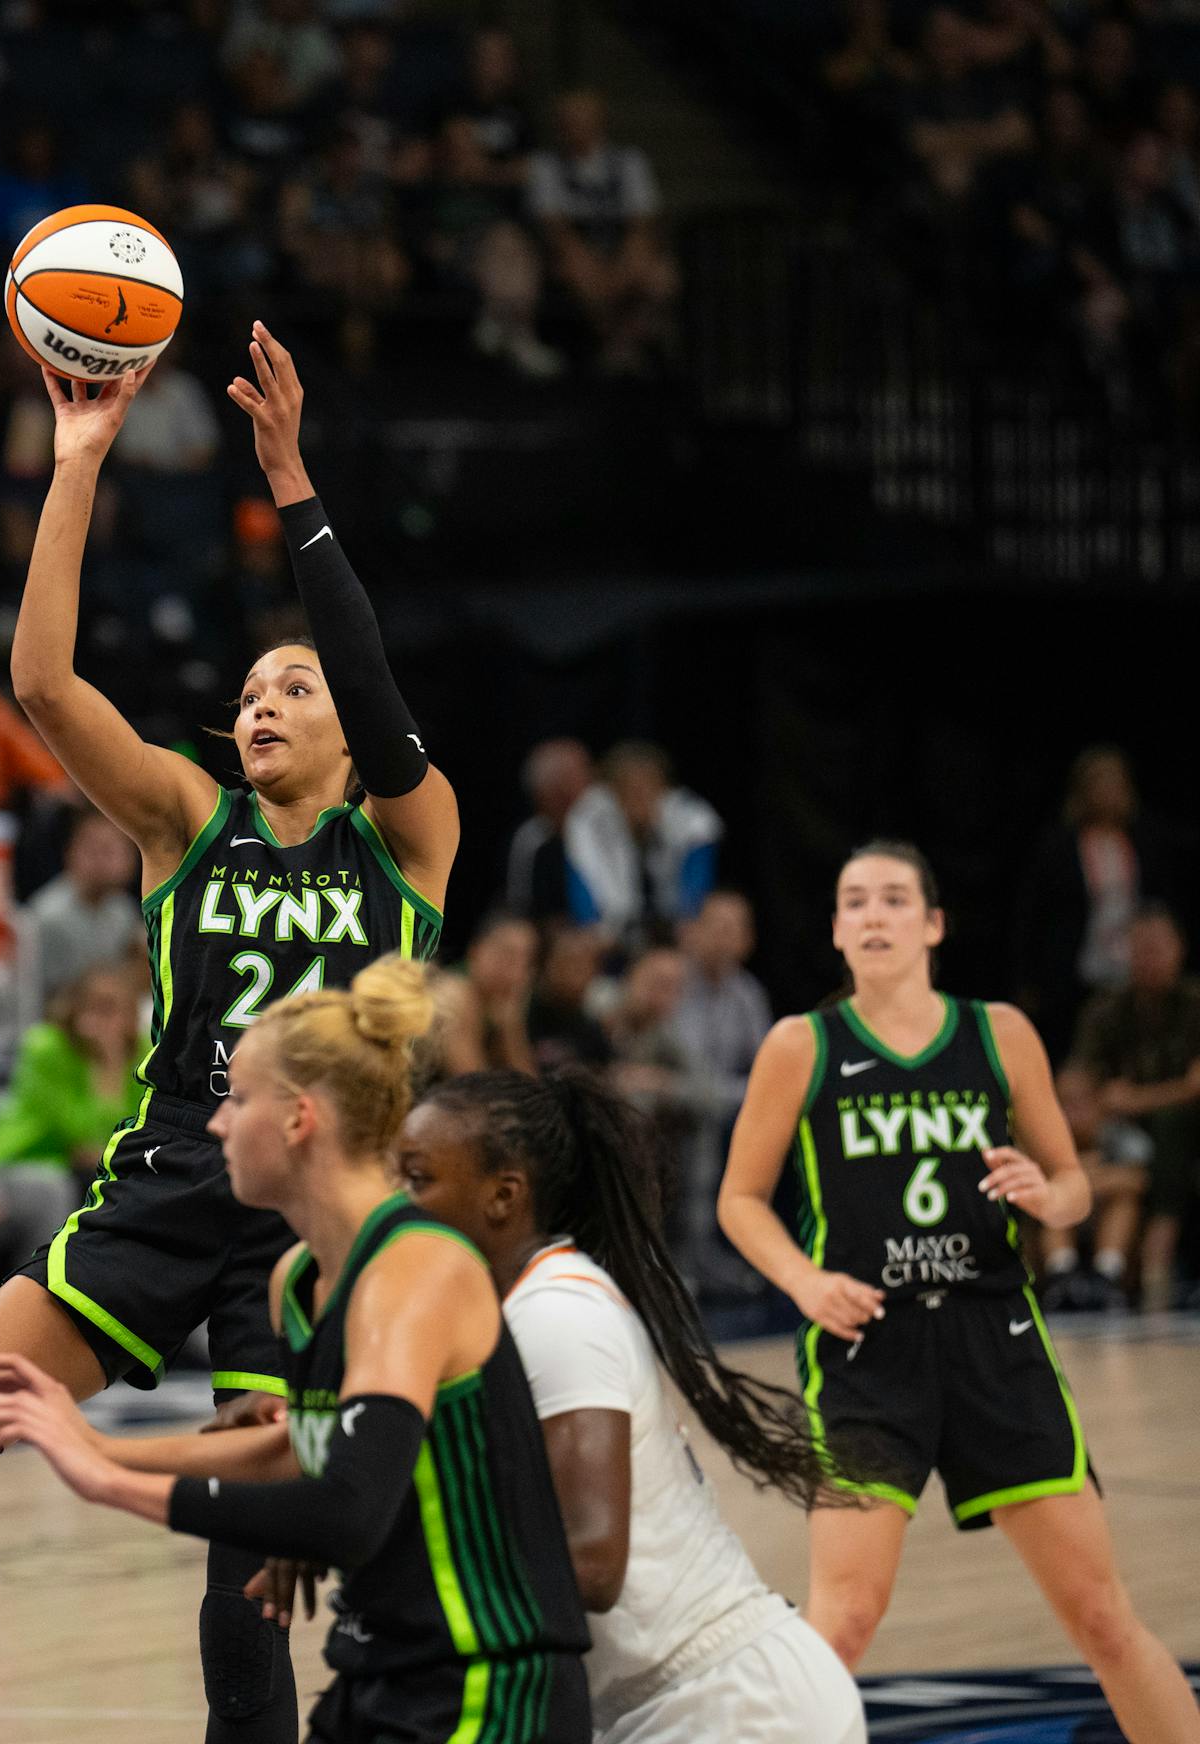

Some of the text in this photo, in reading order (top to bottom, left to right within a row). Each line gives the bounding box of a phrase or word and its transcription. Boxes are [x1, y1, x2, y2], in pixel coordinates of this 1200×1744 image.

[43, 329, 150, 376] Wilson
[199, 880, 369, 946] LYNX
[839, 1104, 993, 1159] LYNX
[903, 1157, 949, 1227] 6
[884, 1233, 971, 1263] MAYO
